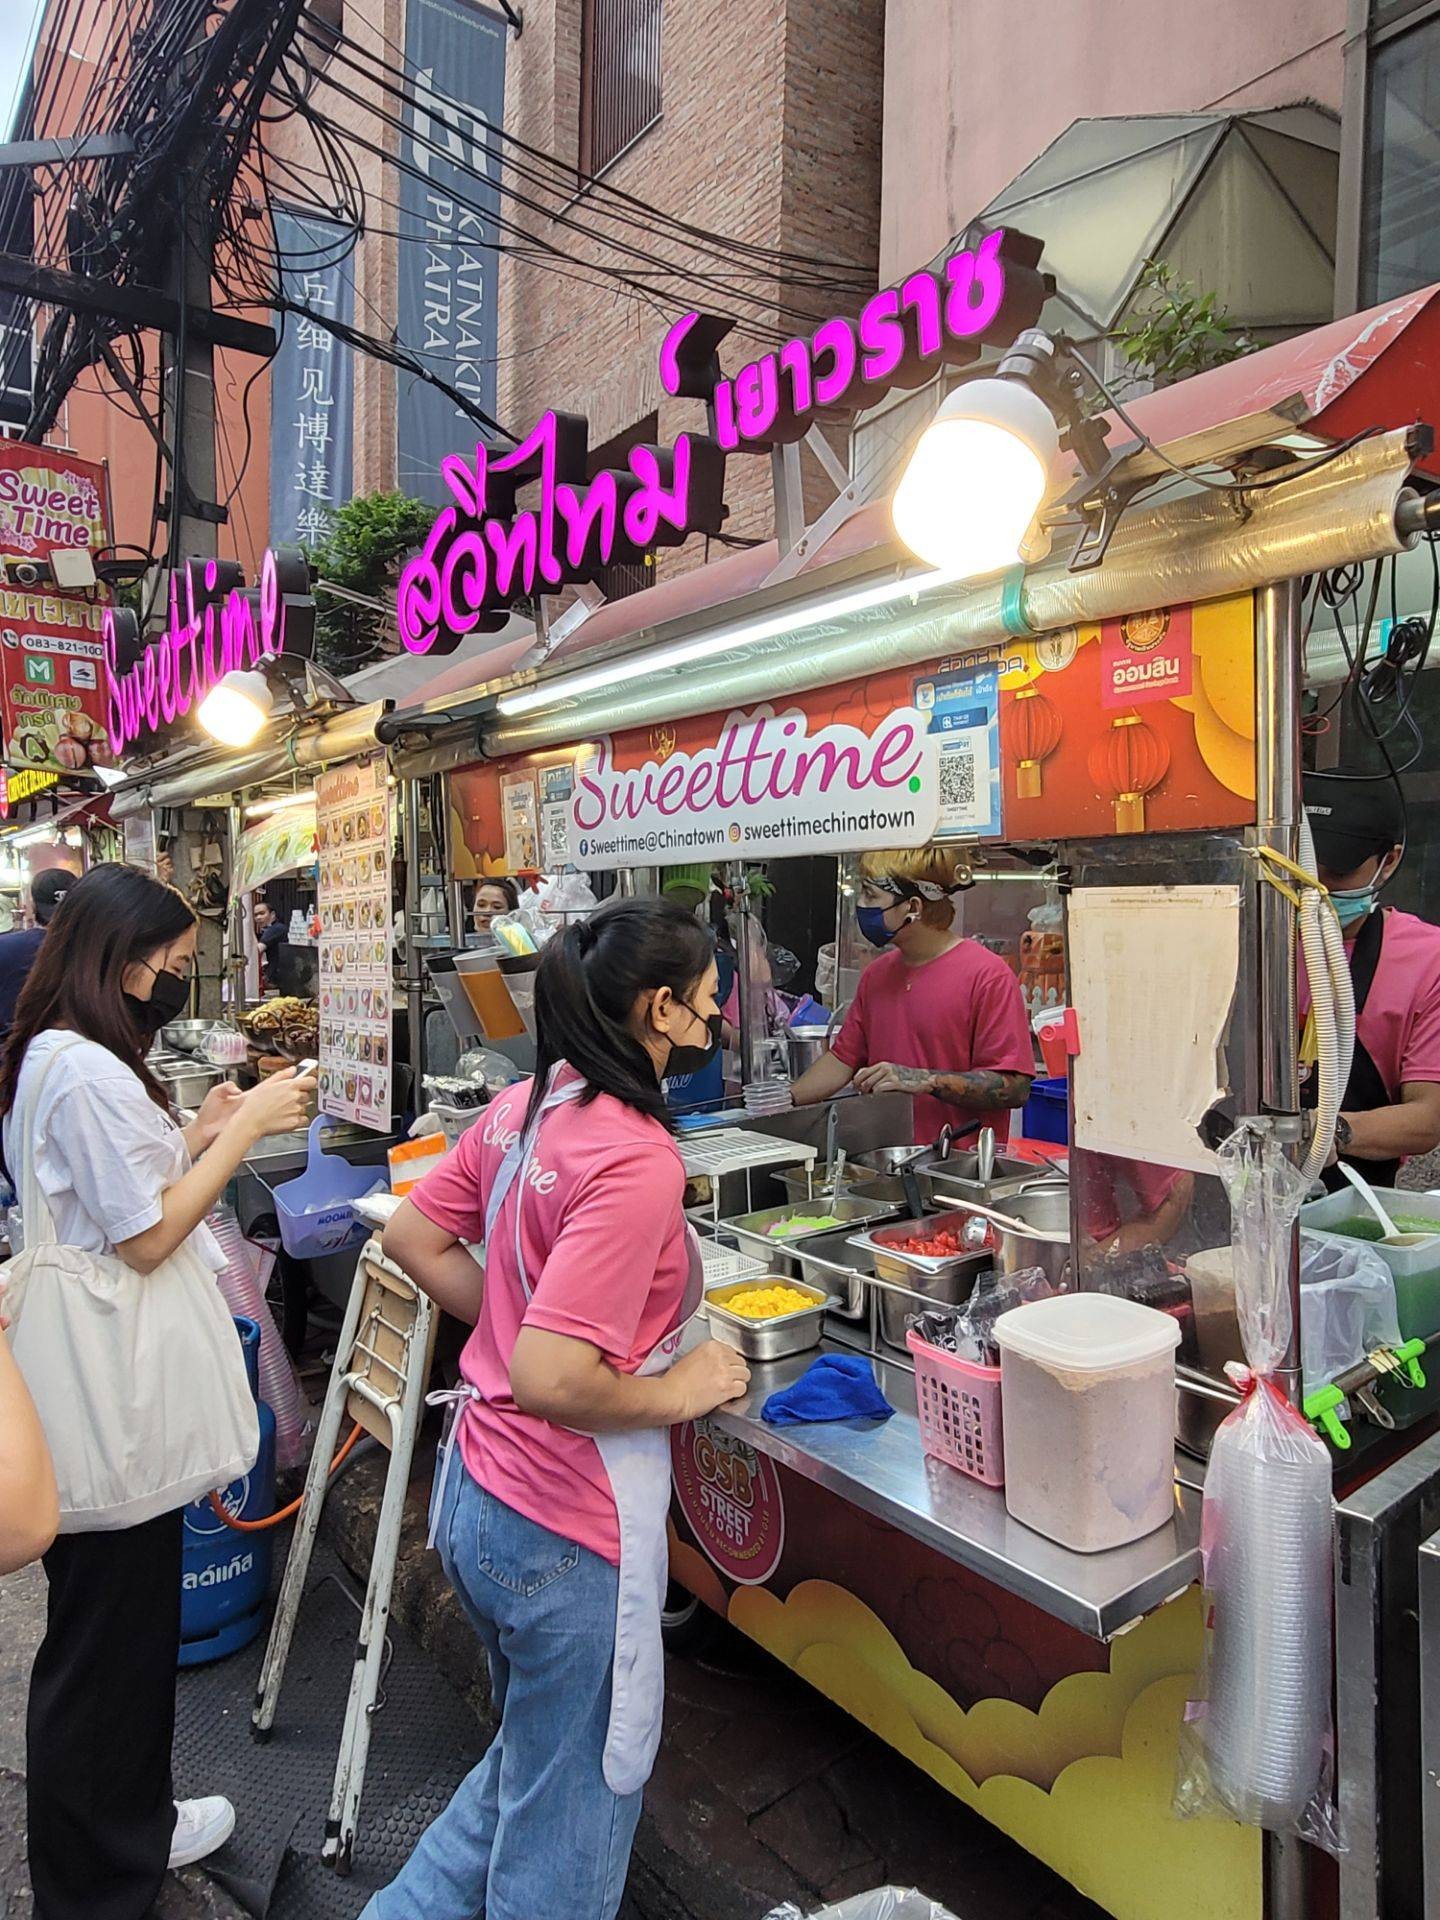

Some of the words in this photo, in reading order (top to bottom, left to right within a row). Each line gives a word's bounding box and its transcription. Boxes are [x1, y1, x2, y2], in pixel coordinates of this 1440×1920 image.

[423, 194, 453, 350] PHATRA
[0, 471, 98, 520] Sweet
[12, 505, 90, 546] Time
[1112, 656, 1180, 685] ออมสิน
[574, 717, 924, 830] Sweettime
[590, 828, 725, 855] Sweettime@Chinatown
[744, 807, 916, 841] sweettimechinatown
[694, 1436, 754, 1508] GSB
[700, 1486, 751, 1537] STREET
[708, 1510, 744, 1546] FOOD
